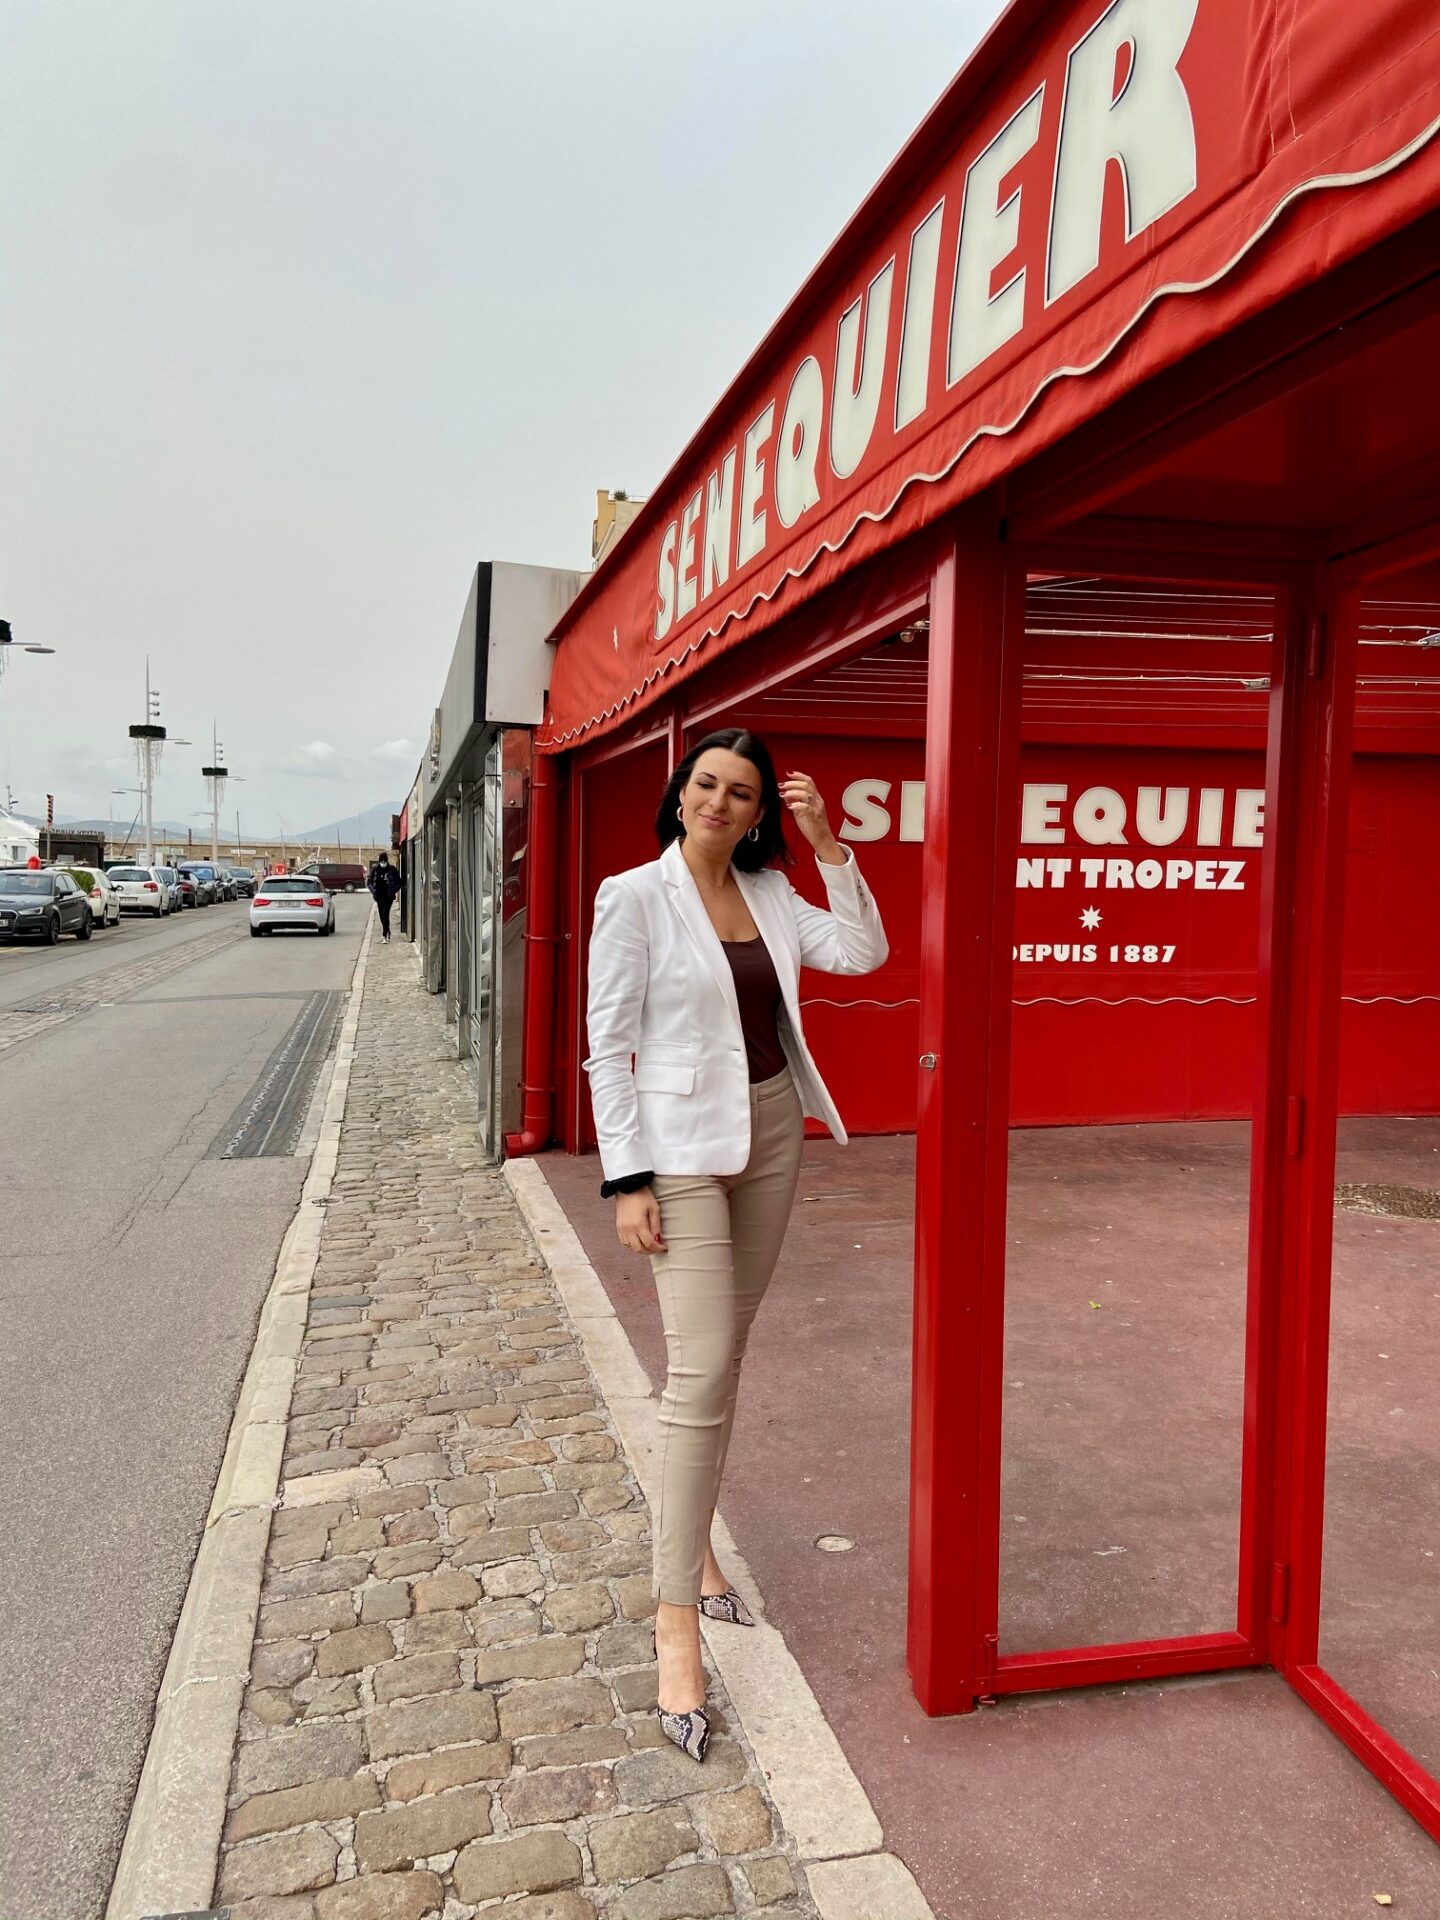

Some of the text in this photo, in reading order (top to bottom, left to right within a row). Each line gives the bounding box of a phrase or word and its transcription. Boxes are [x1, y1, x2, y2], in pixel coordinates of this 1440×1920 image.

[654, 0, 1200, 640] SENEQUIER
[838, 778, 1266, 847] SEQUIE
[1079, 859, 1246, 890] TROPEZ
[1012, 944, 1177, 963] EPUIS 1887
